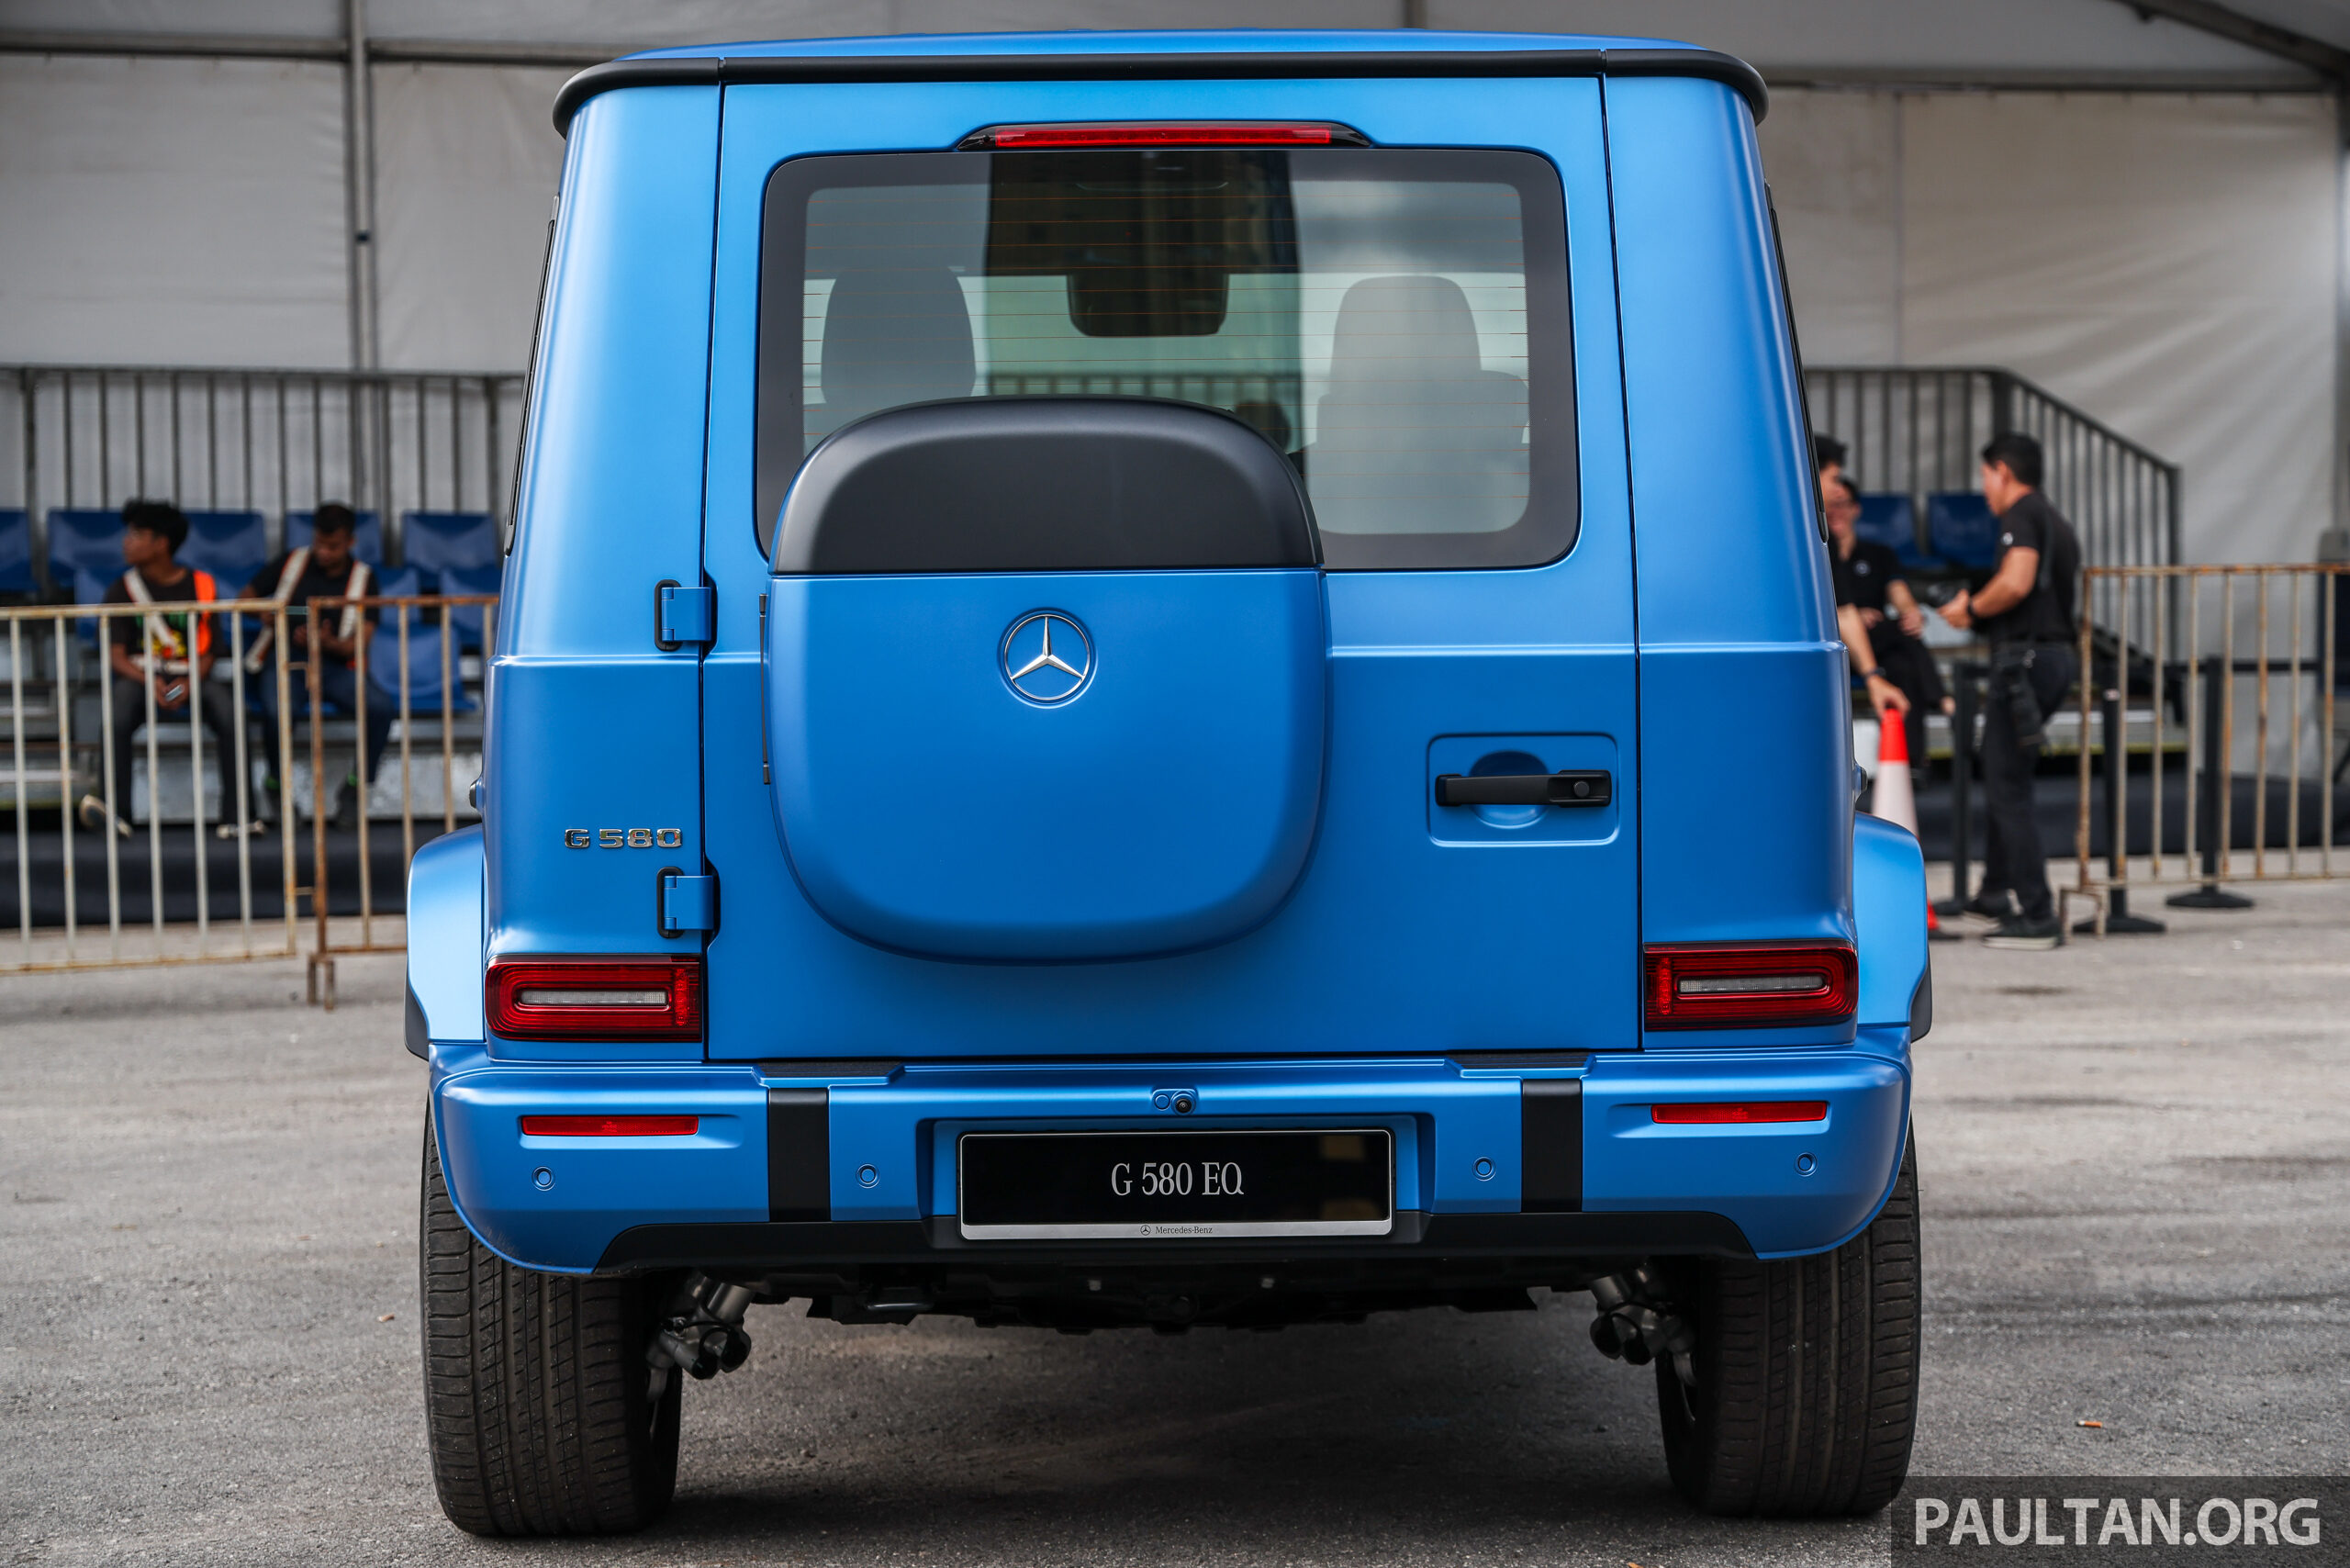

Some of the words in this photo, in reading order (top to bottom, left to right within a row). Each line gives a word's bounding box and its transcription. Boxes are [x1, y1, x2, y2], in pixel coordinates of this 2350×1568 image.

[565, 828, 590, 848] G
[599, 828, 682, 848] 580
[1111, 1162, 1133, 1196] G
[1142, 1162, 1192, 1195] 580
[1202, 1161, 1245, 1195] EQ
[1155, 1226, 1214, 1235] Mercedes-Benz
